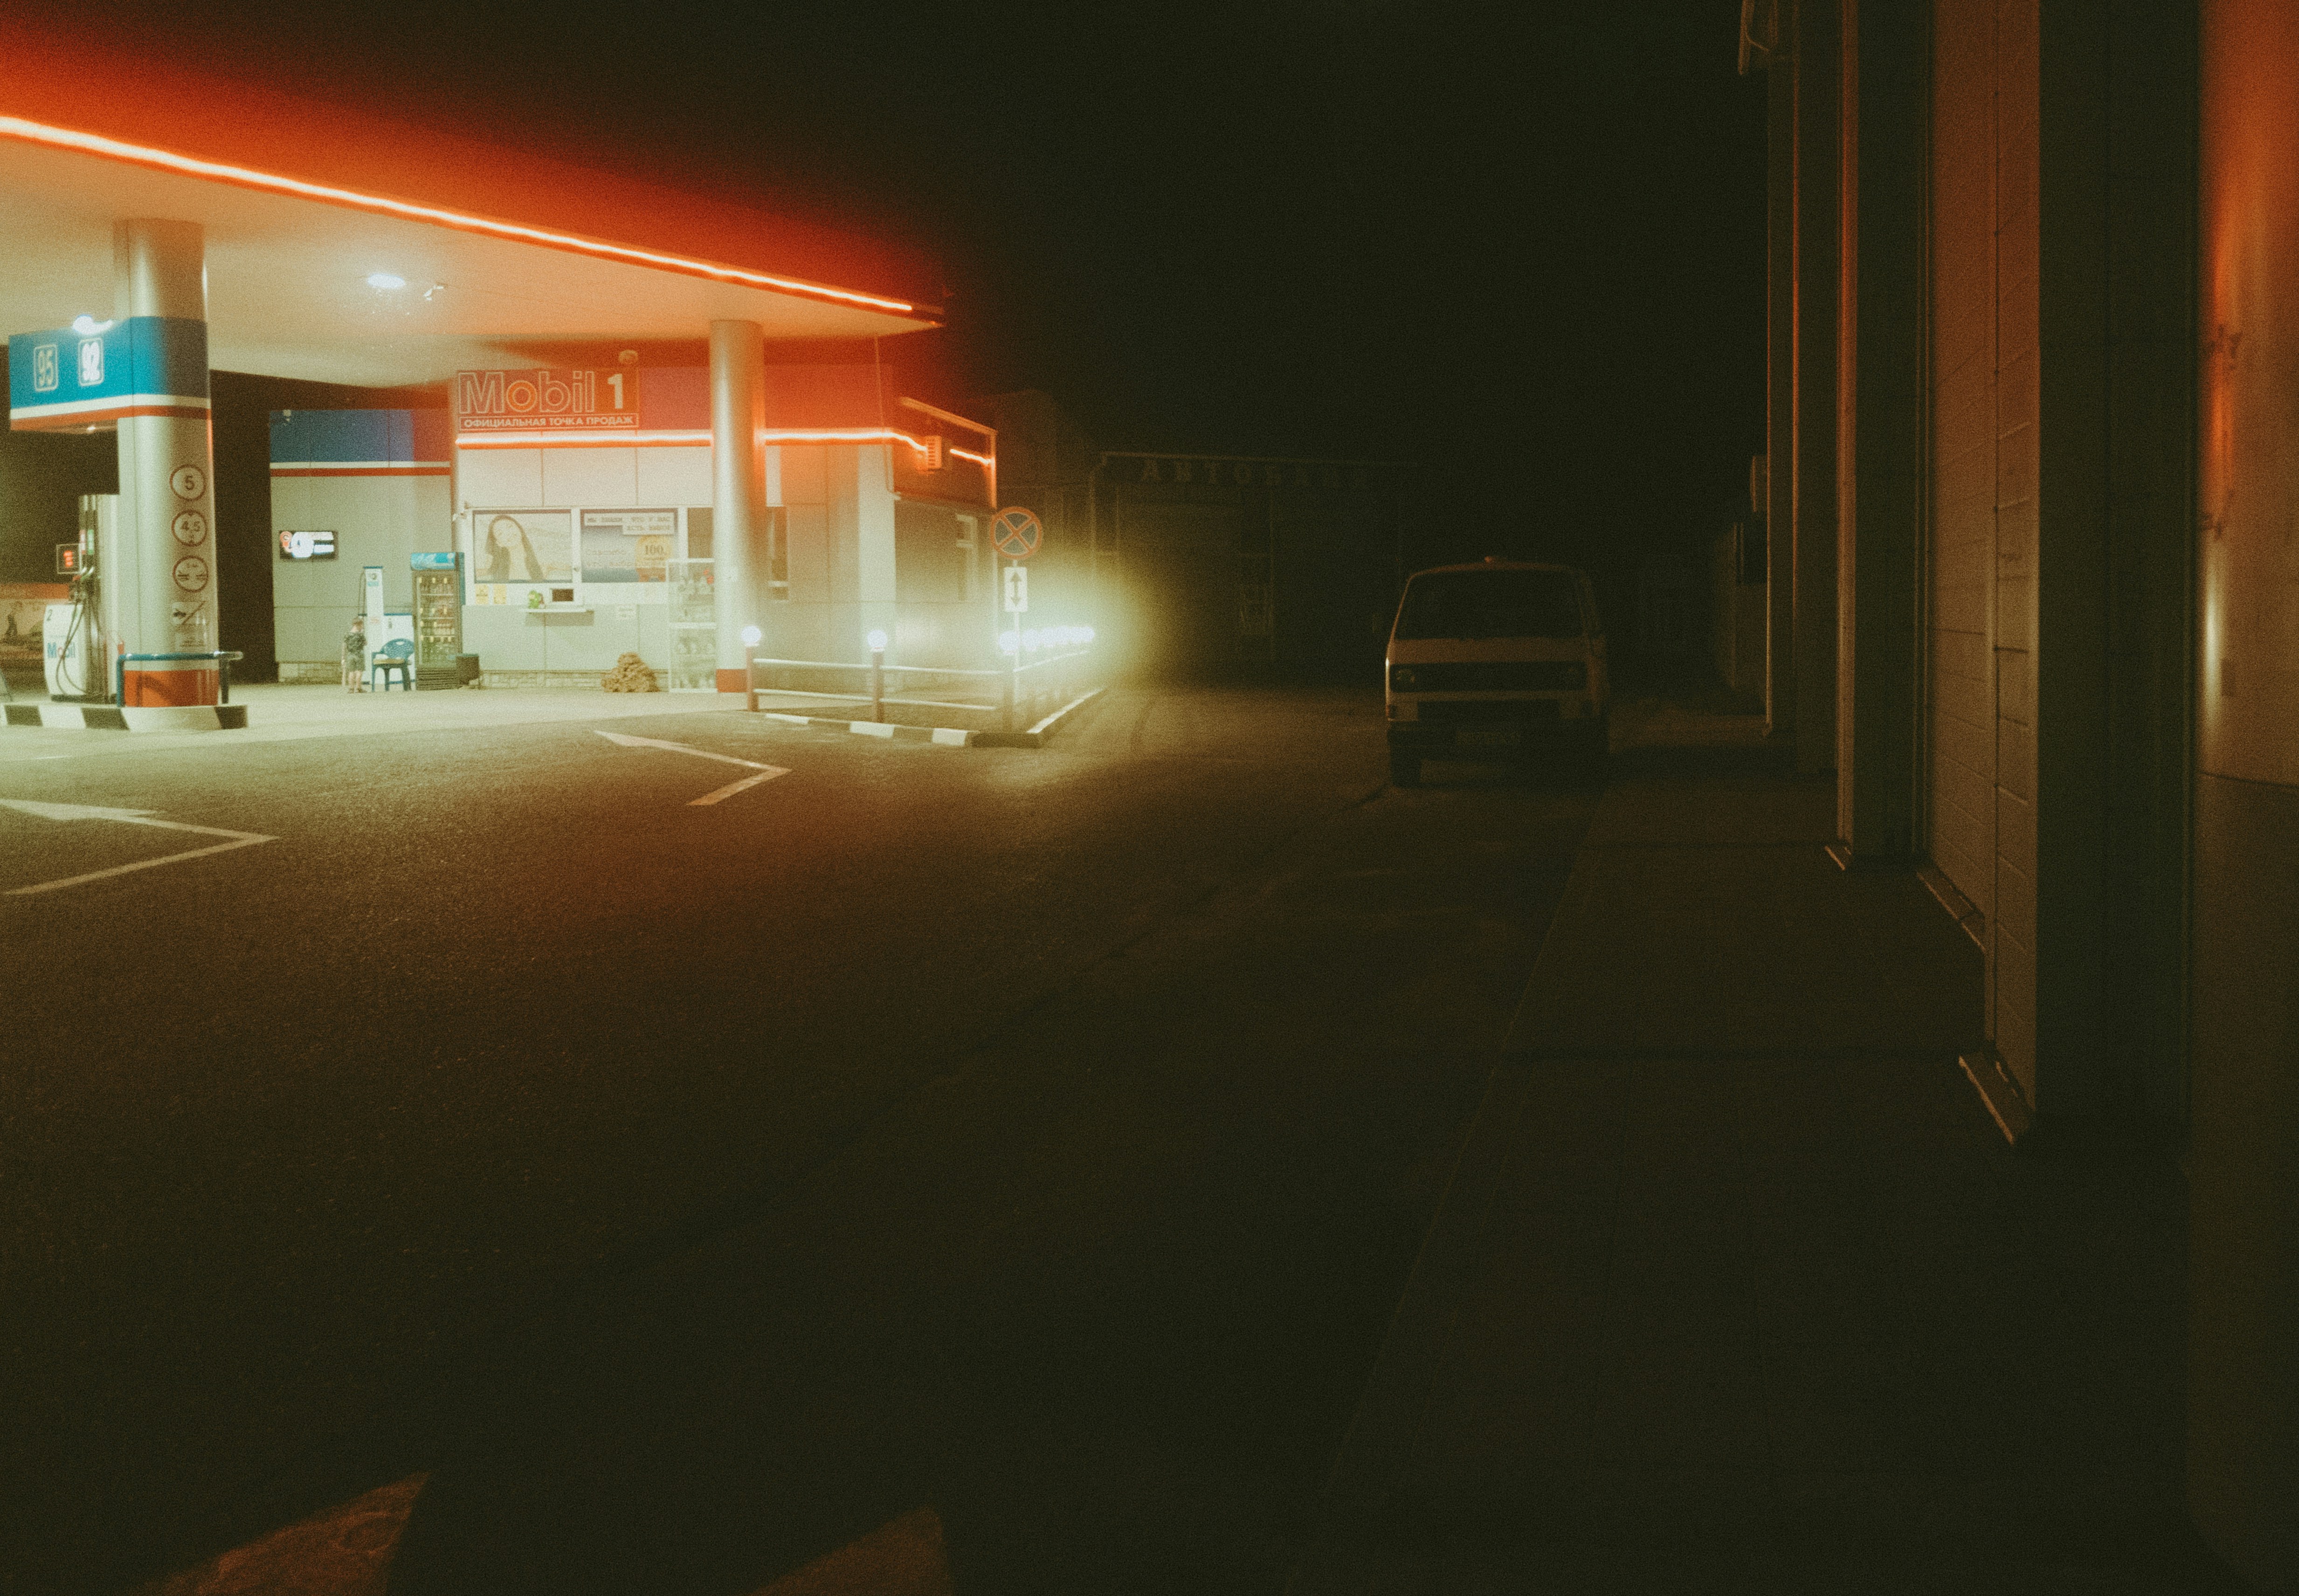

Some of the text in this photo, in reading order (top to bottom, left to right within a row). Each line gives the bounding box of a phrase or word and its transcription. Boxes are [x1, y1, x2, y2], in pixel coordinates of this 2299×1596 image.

[38, 349, 54, 387] 95
[458, 370, 623, 414] Mobil 1
[463, 415, 634, 428] ОФИЦИАЛЬНАЯ ТОЧКА ПРОДАЖ
[184, 475, 195, 491] 5
[47, 609, 53, 621] 2
